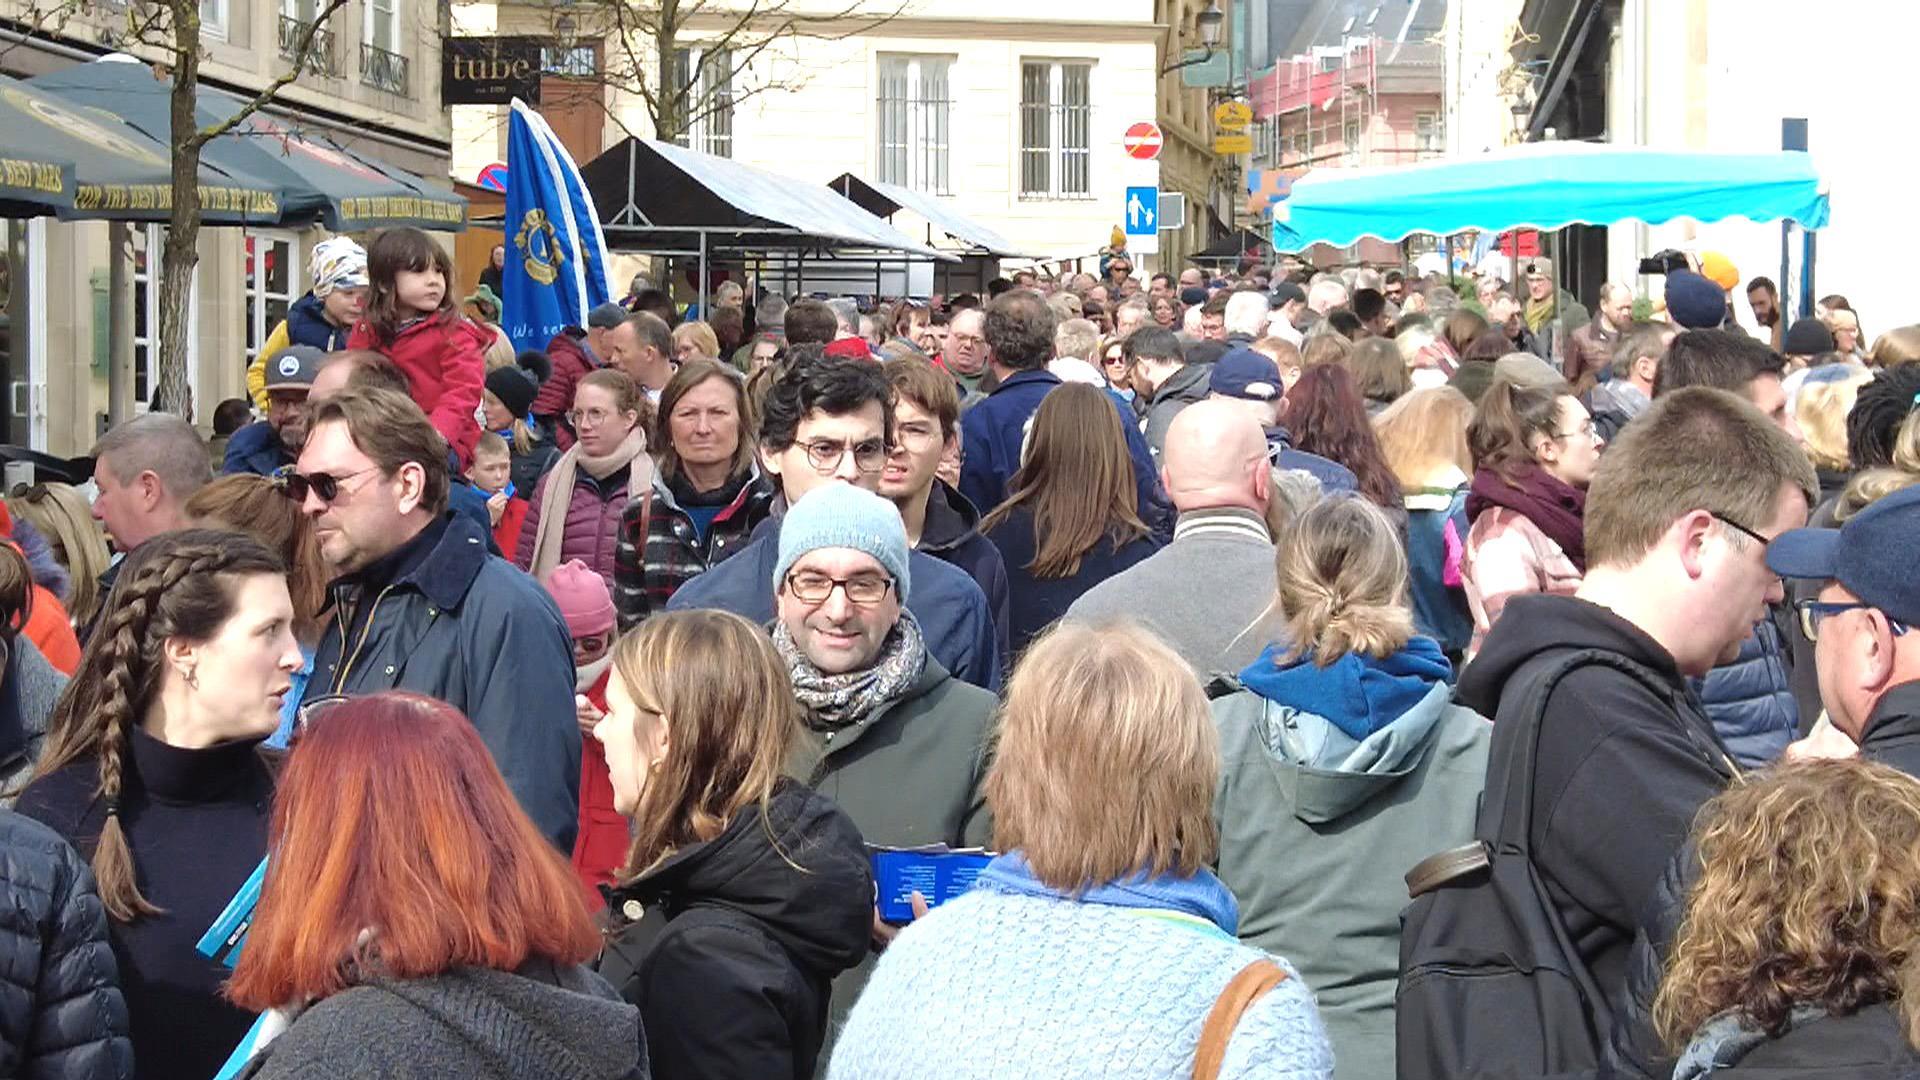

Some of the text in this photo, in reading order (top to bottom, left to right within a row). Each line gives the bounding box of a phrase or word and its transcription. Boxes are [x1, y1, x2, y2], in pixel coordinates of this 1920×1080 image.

[453, 47, 530, 80] tube
[2, 158, 62, 193] BEST BARS
[74, 185, 101, 209] FOR
[103, 184, 127, 208] THE
[130, 184, 155, 208] BEST
[513, 323, 568, 339] We ser
